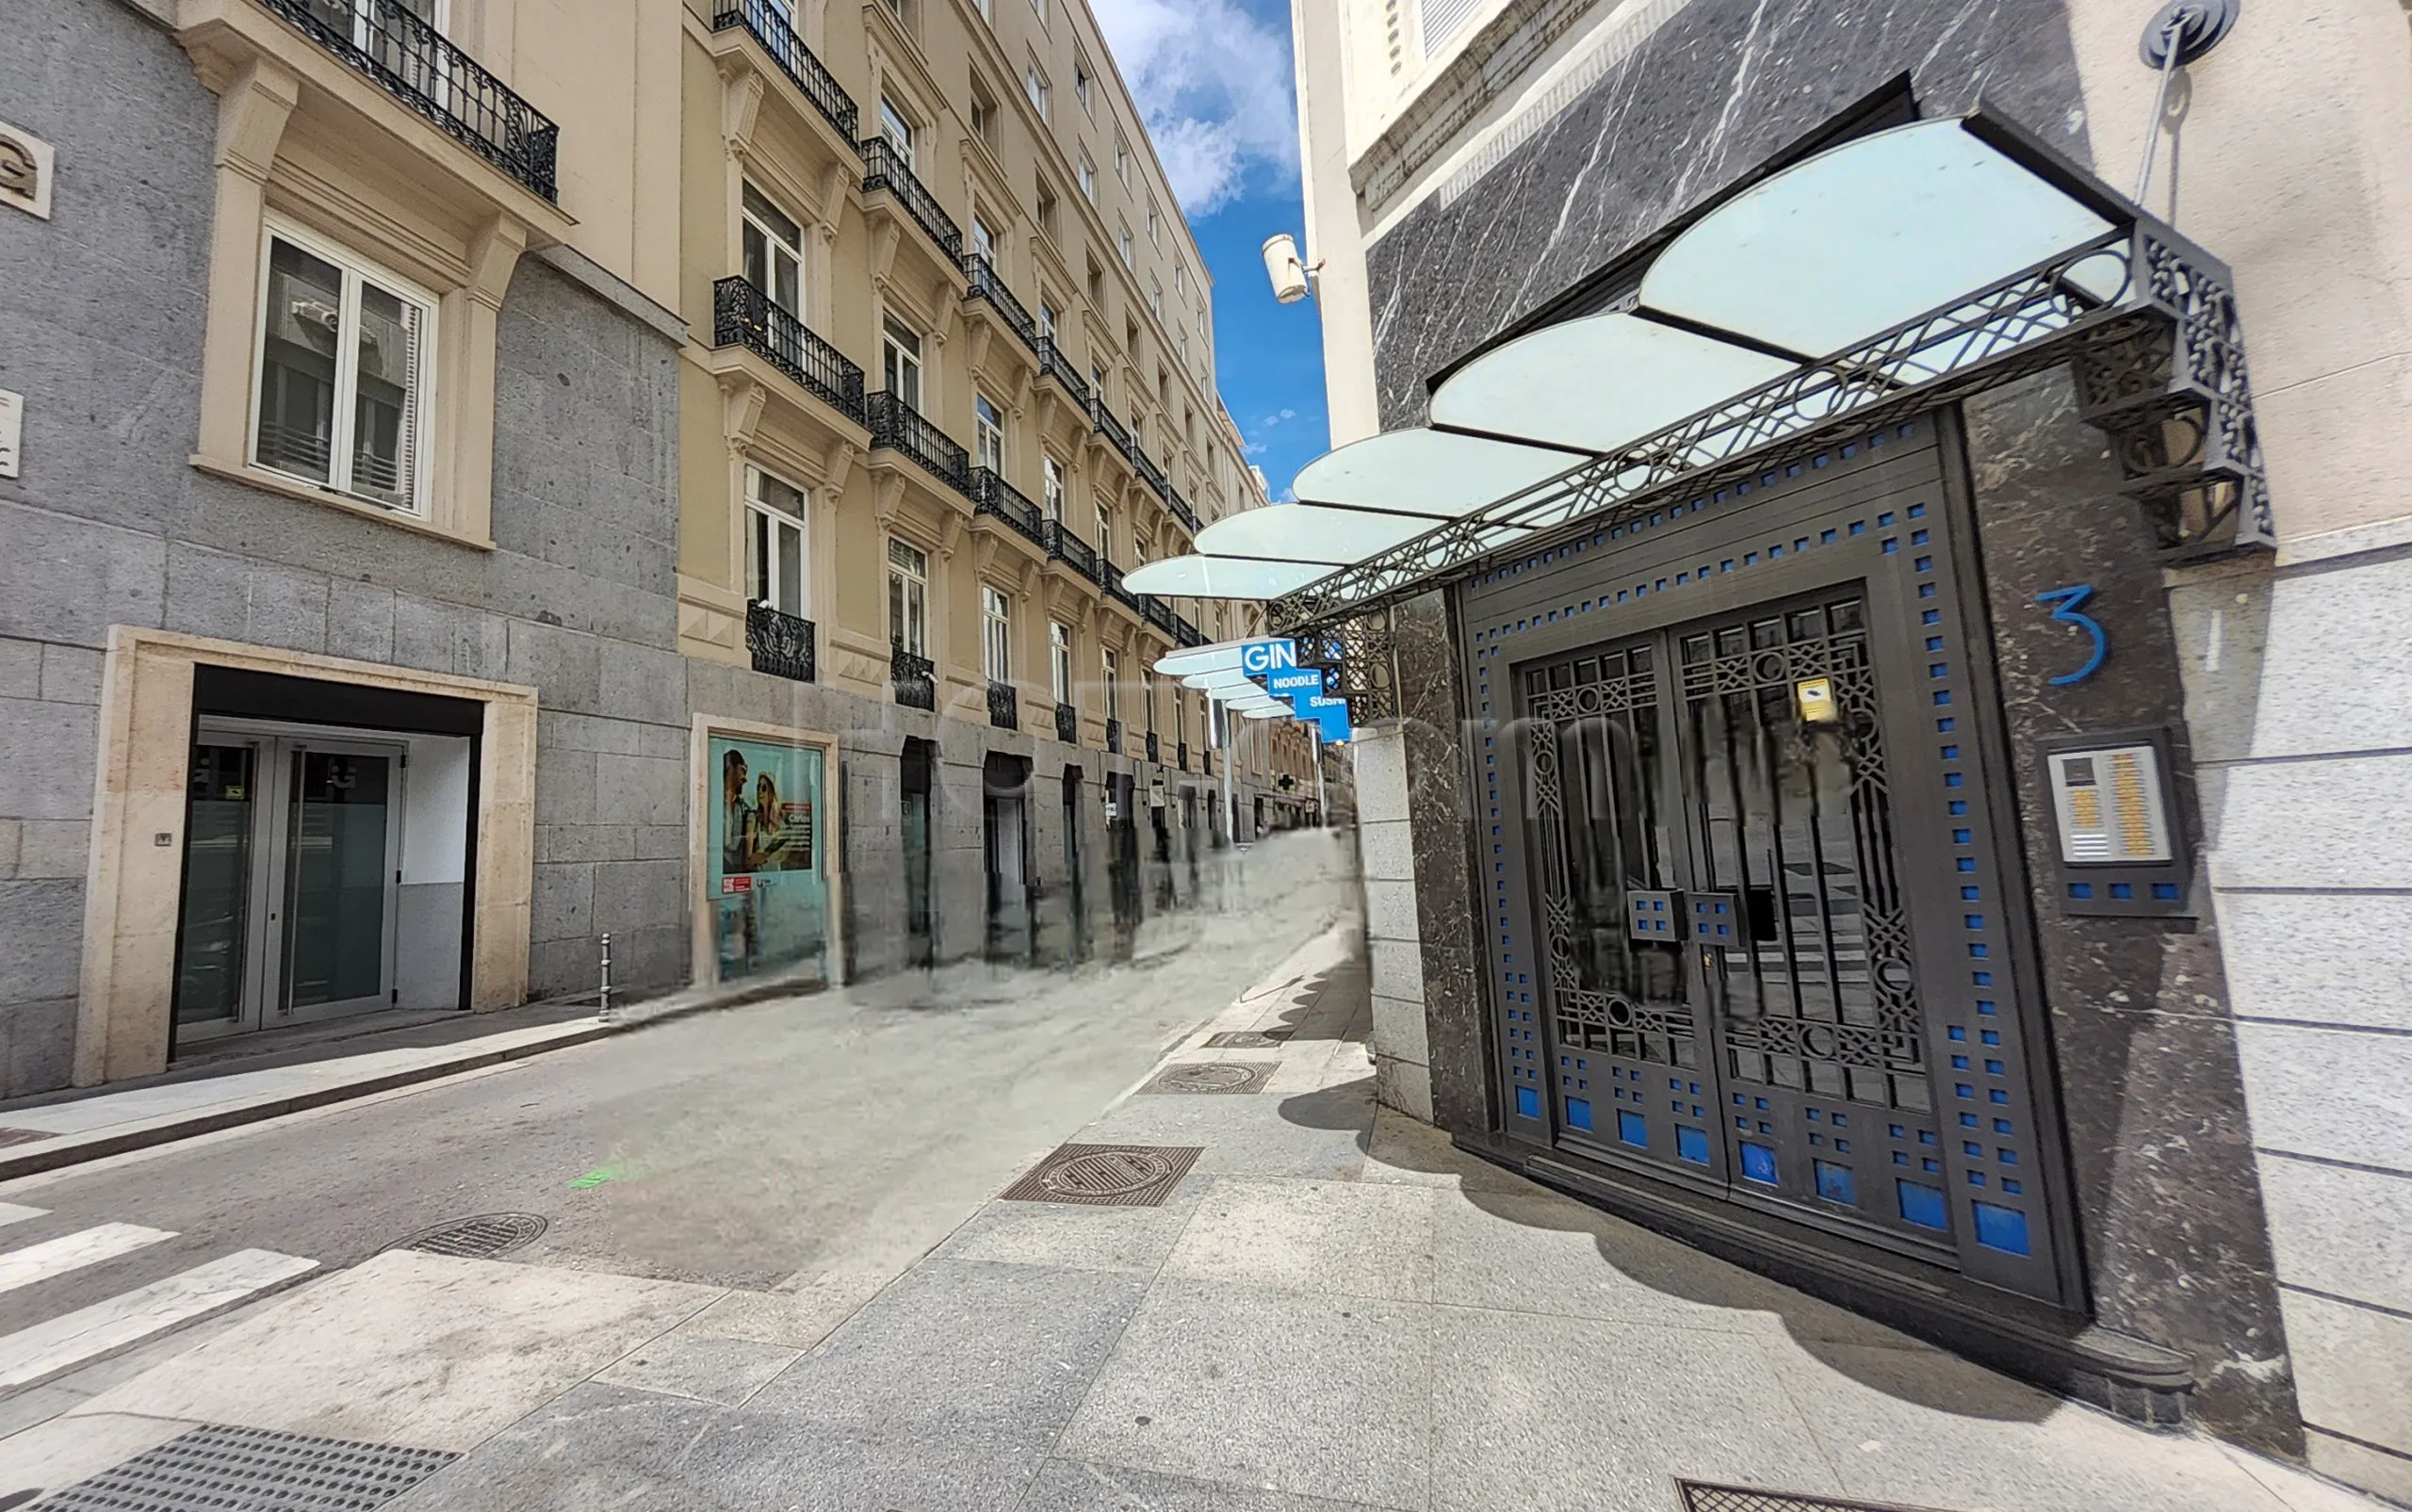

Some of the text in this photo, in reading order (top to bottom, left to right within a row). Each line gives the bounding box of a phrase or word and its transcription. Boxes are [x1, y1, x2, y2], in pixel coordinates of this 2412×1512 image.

[2035, 583, 2107, 686] 3
[1245, 642, 1296, 671] GIN
[1274, 675, 1319, 689] NOODLE
